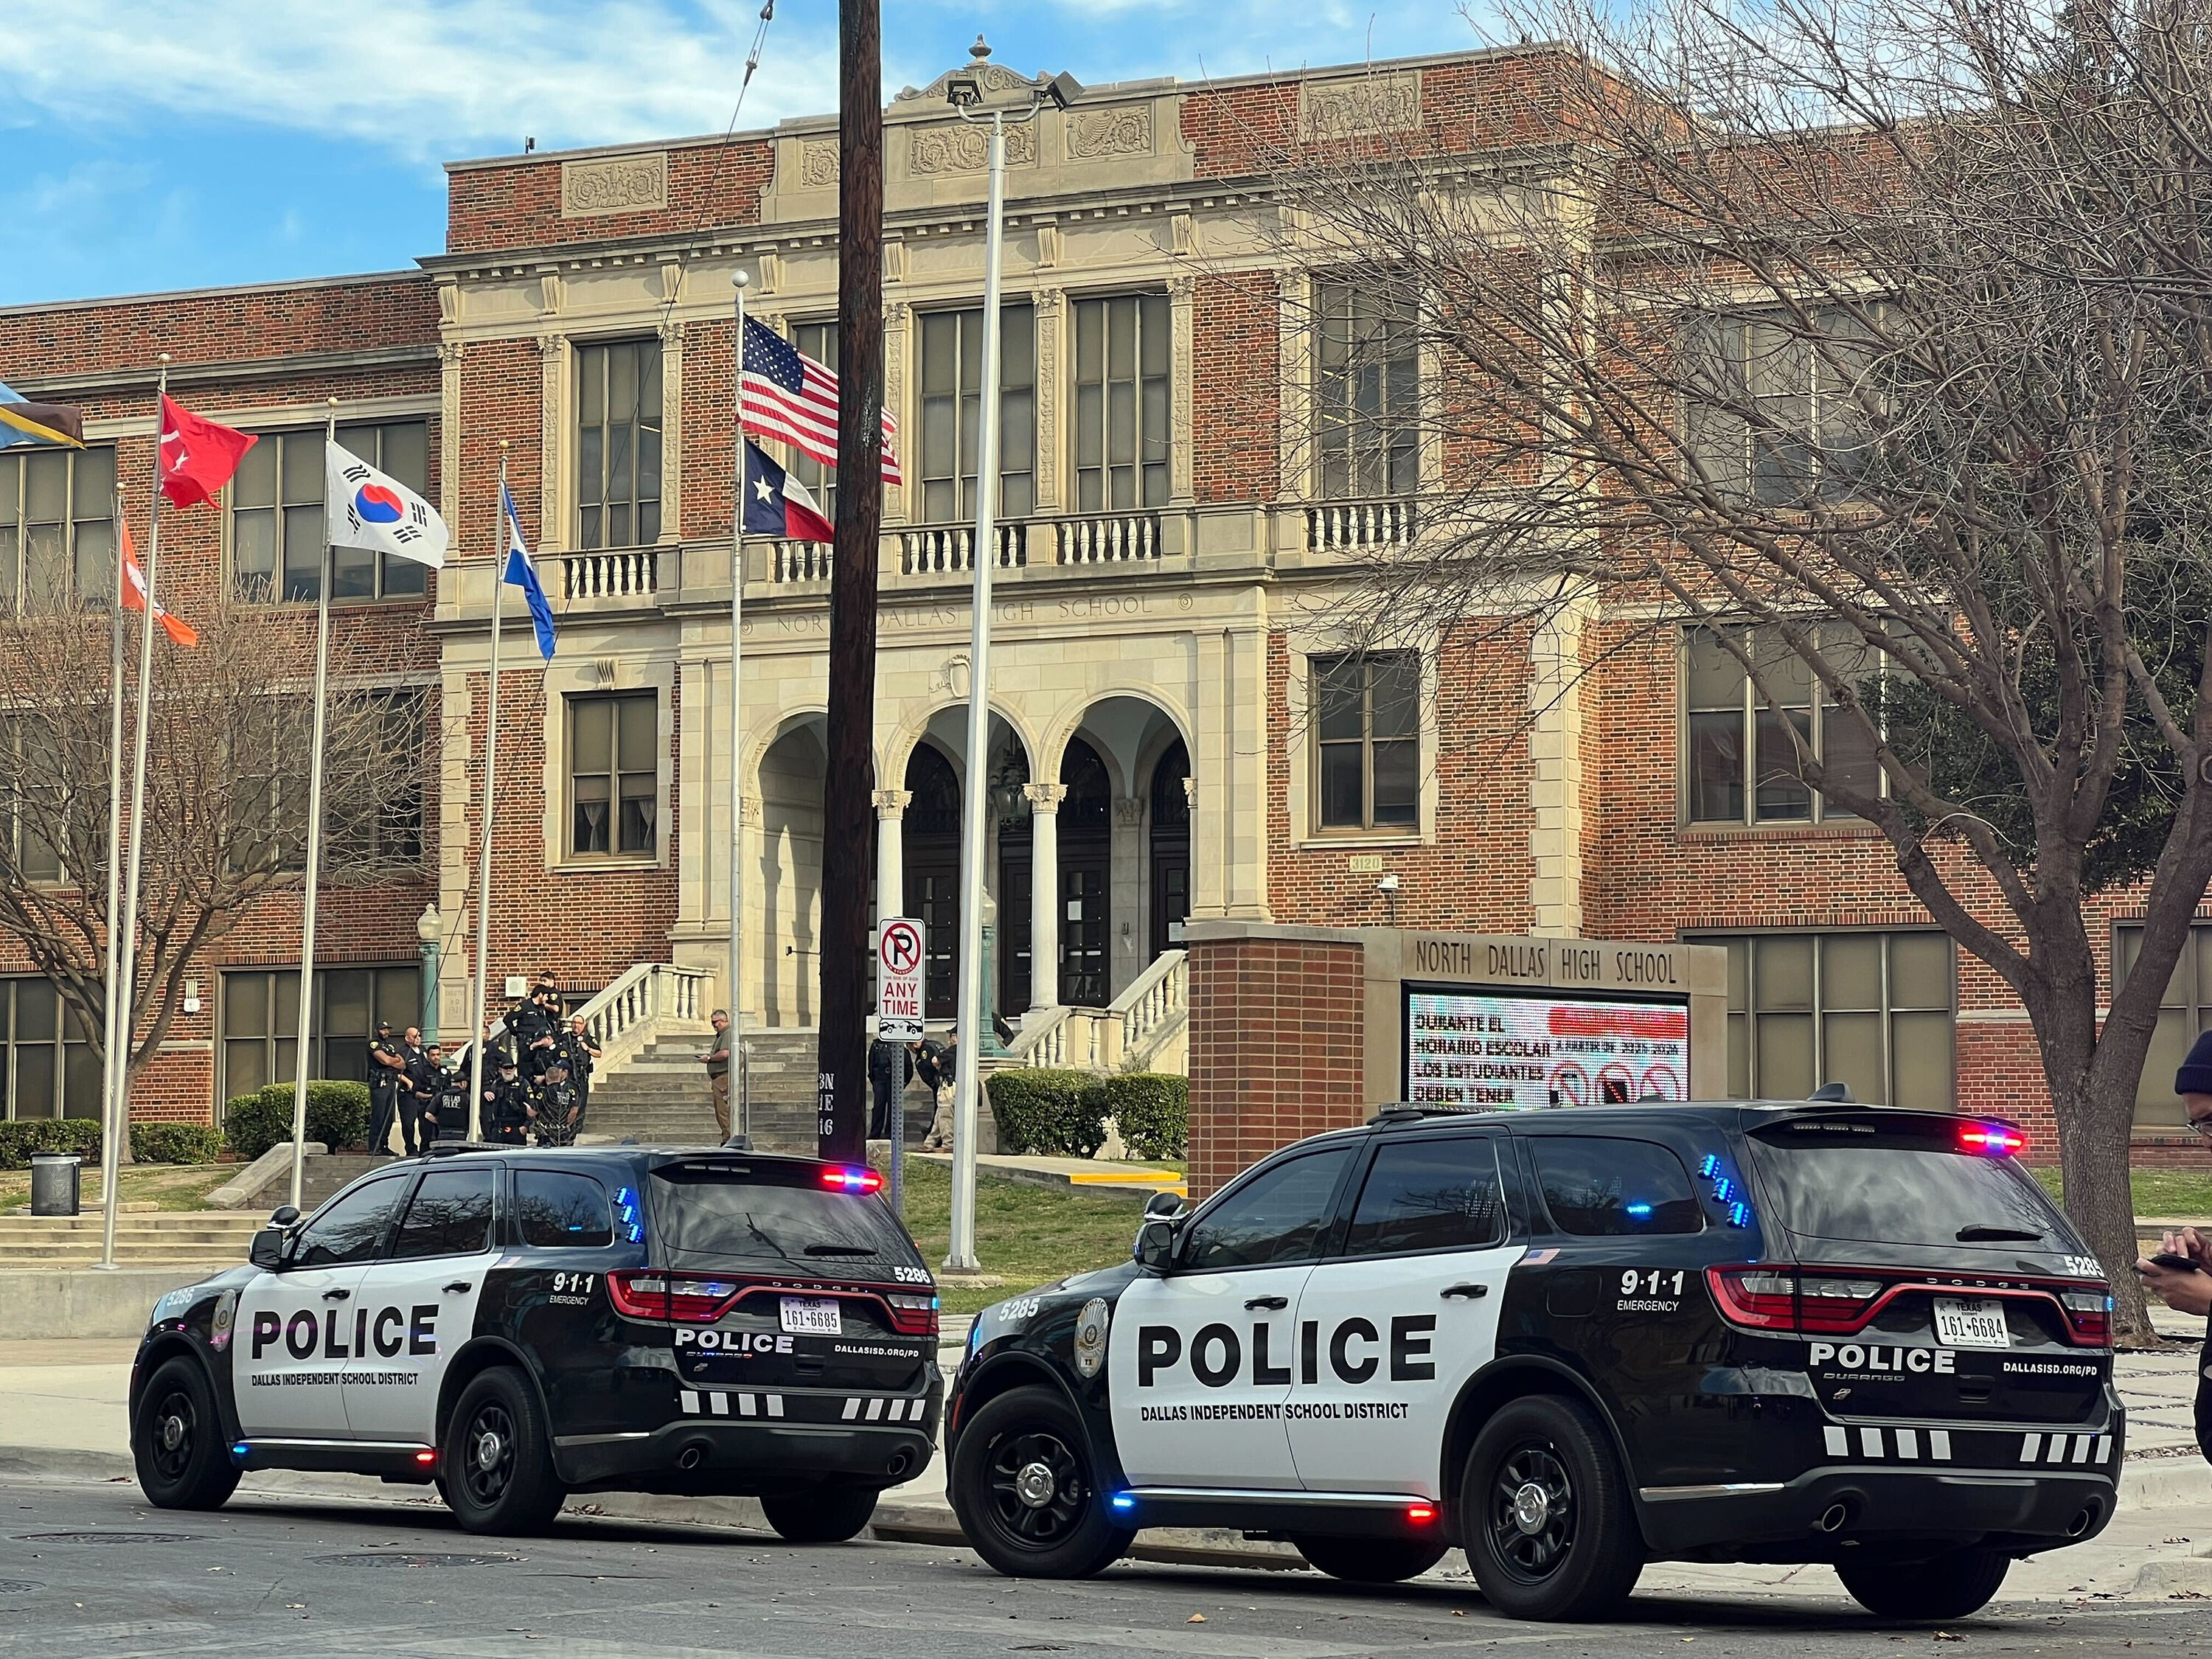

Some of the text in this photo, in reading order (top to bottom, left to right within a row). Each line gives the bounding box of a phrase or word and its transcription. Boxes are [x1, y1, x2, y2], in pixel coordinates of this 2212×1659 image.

[995, 602, 1034, 622] IGH
[1059, 588, 1152, 618] SCHOOL
[1352, 858, 1380, 869] 3120
[1416, 941, 1676, 984] NORTH DALLAS HIGH SCHOOL
[884, 982, 917, 998] ANY
[883, 1000, 918, 1015] TIME
[1414, 1014, 1505, 1032] DURANTE EL
[1414, 1038, 1549, 1057] HORARIO ESCOLAR
[1414, 1062, 1545, 1080] LOS ESTUDIANTES
[1413, 1086, 1514, 1104] DEBEN TENER
[894, 1267, 931, 1284] 5286
[2064, 1256, 2105, 1278] 5285
[773, 1281, 858, 1293] DODGE
[1927, 1277, 2029, 1290] DODGE
[167, 1288, 195, 1307] 5286
[549, 1295, 589, 1305] EMERGENCY
[1617, 1300, 1680, 1312] EMERGENCY
[998, 1298, 1040, 1321] 5285
[1955, 1303, 1982, 1312] TEXAS
[251, 1304, 439, 1360] POLICE
[675, 1329, 794, 1354] POLICE
[835, 1344, 919, 1358] DALLASISD.ORG/PD
[1137, 1315, 1437, 1388] POLICE
[1809, 1343, 1955, 1374] POLICE
[1823, 1373, 1905, 1381] DURANGO
[2003, 1362, 2098, 1377] DALLASISD.ORG/PD
[251, 1373, 418, 1386] DALLAS INDEPENDENT SCHOOL DISTRICT
[1142, 1403, 1408, 1421] DALLAS INDEPENDENT SCHOOL DISTRICT
